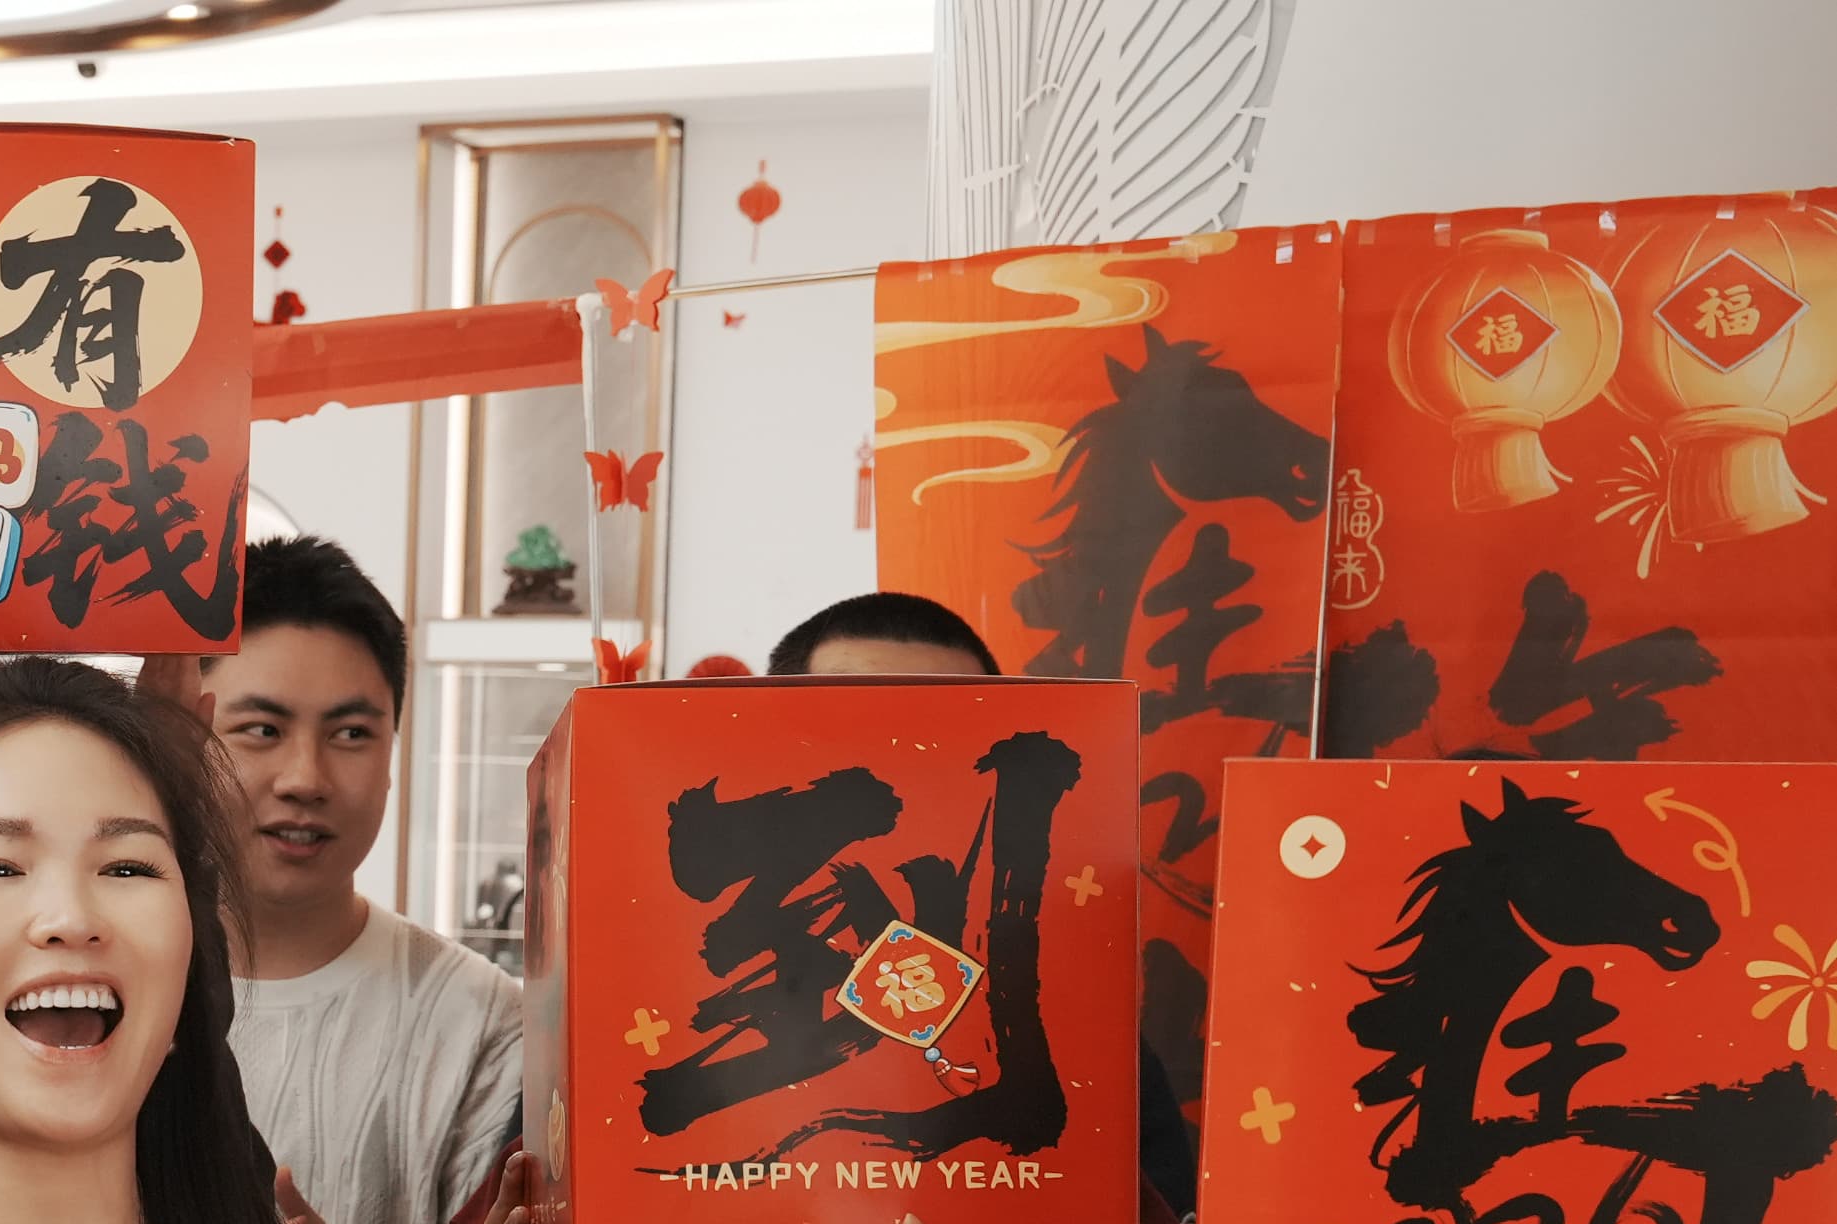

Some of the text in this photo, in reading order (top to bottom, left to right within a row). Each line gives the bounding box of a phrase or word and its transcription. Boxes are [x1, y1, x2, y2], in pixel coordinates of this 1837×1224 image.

[1475, 314, 1524, 355] 福
[1694, 286, 1761, 341] 福
[875, 953, 947, 1019] 福
[682, 1161, 1041, 1190] HAPPY NEW YEAR
